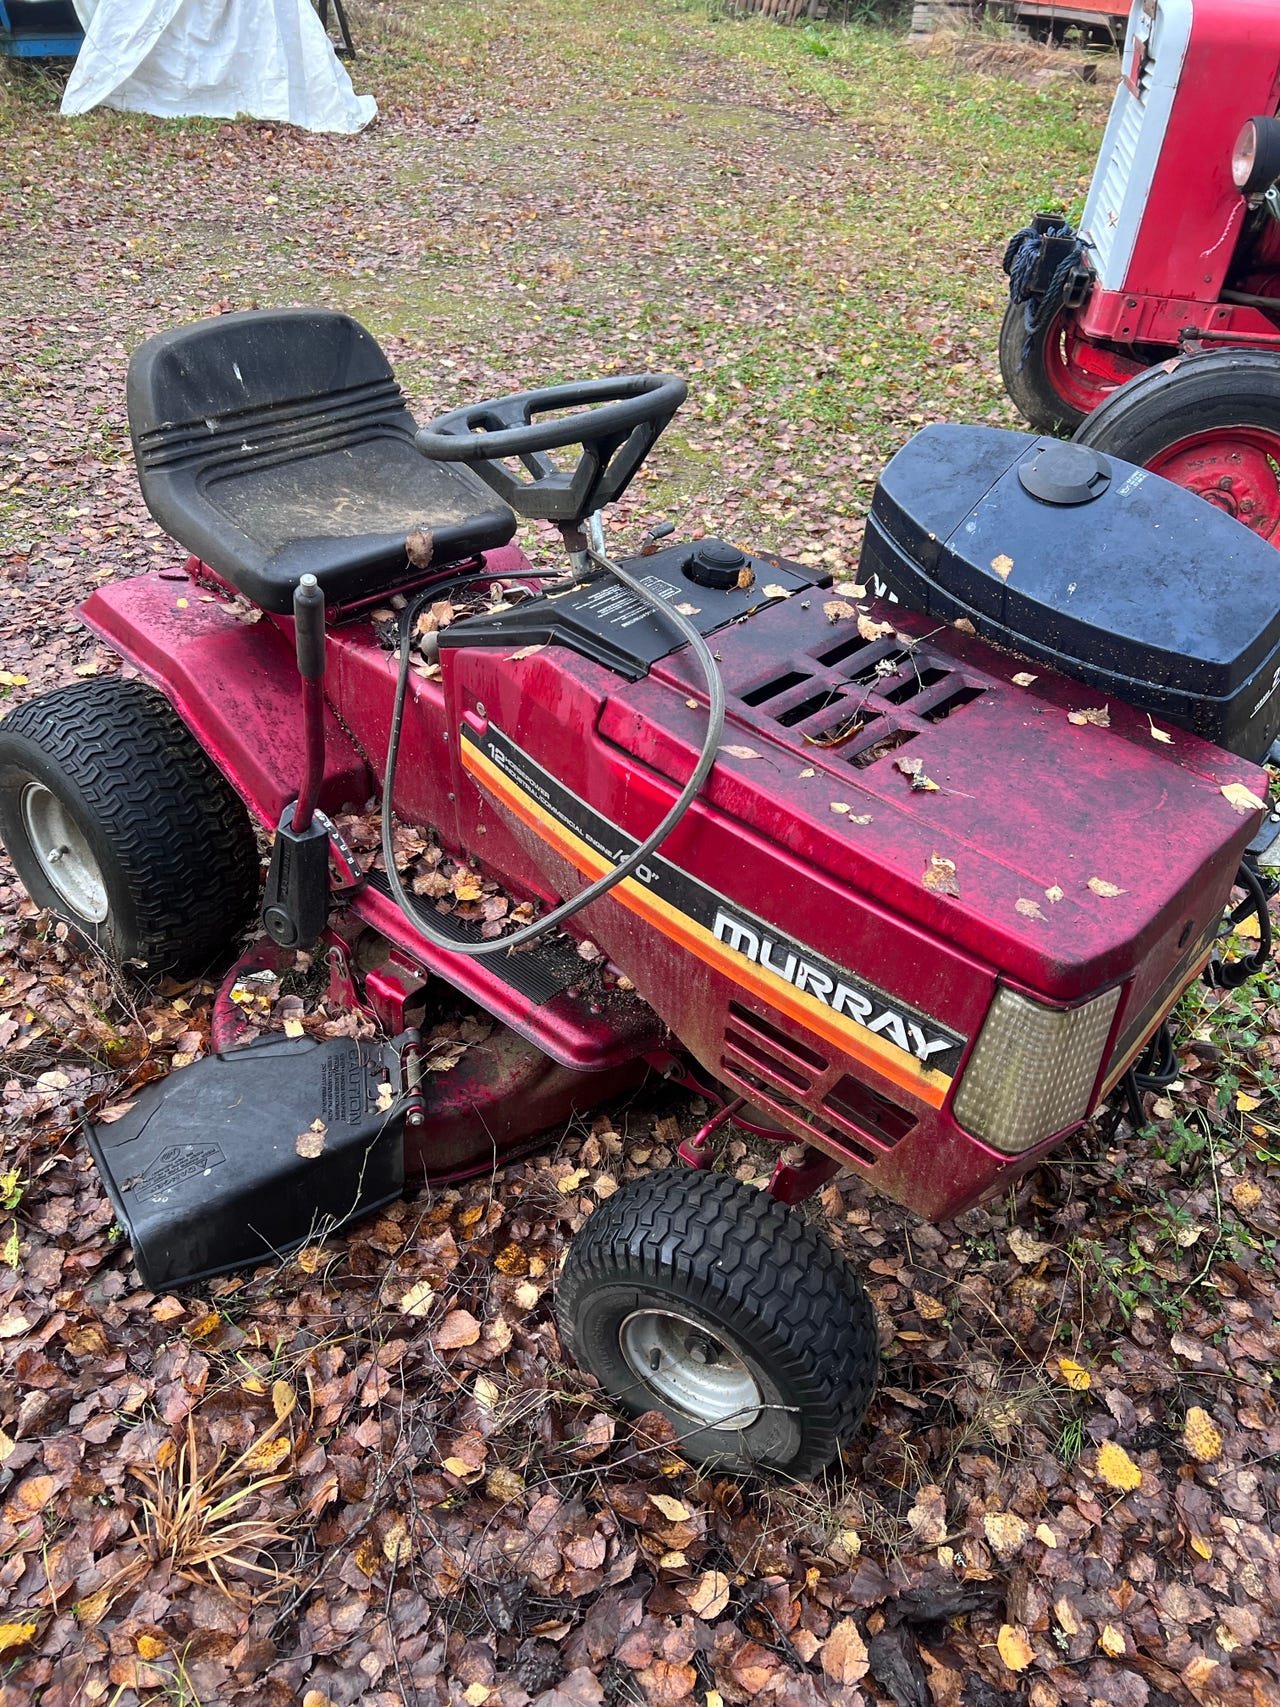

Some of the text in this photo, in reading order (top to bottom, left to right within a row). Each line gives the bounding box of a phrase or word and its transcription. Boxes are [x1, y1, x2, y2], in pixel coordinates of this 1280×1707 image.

[487, 742, 550, 799] 12 HORSEPOWER
[713, 911, 953, 1061] MURRAY
[348, 1048, 361, 1127] CAUTION
